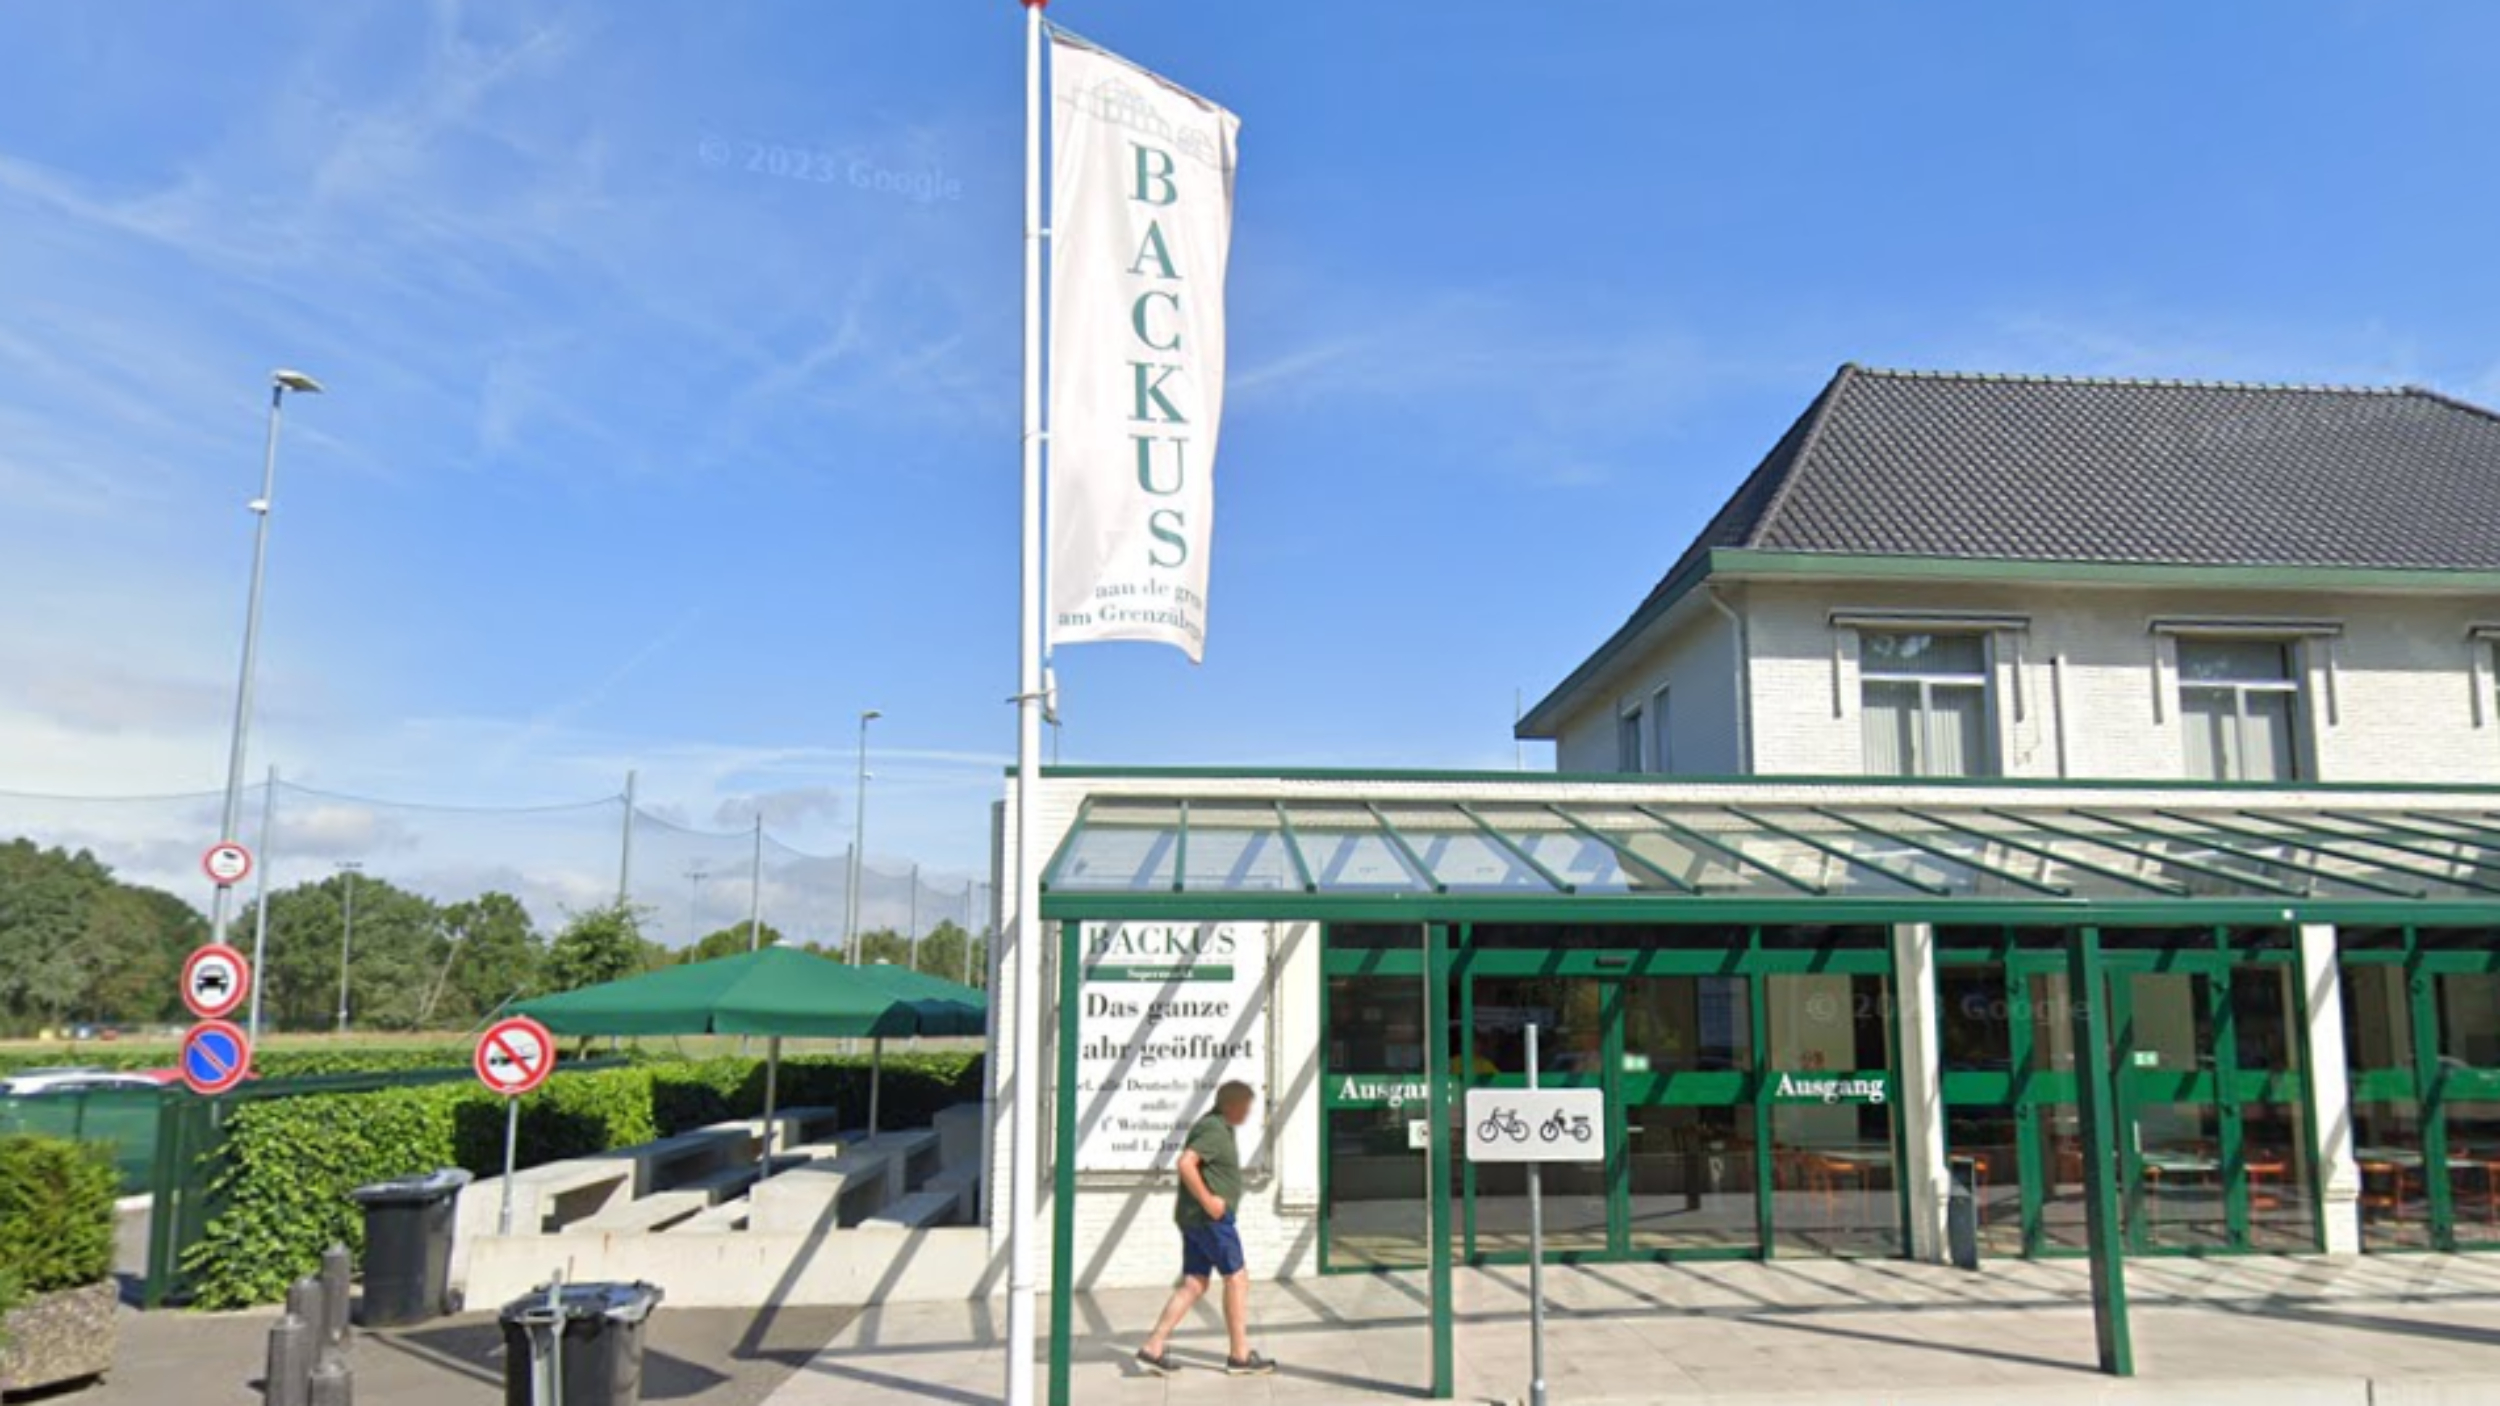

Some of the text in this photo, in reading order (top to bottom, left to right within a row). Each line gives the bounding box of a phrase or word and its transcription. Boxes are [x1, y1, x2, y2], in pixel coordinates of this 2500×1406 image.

[1125, 139, 1190, 568] BACKUS
[1058, 611, 1092, 626] am
[1088, 926, 1236, 955] BACKUS
[1087, 993, 1230, 1026] Das ganze
[1083, 1035, 1252, 1068] ahr geöffnet
[1338, 1075, 1452, 1107] Ausgan
[1775, 1071, 1885, 1104] Ausgang
